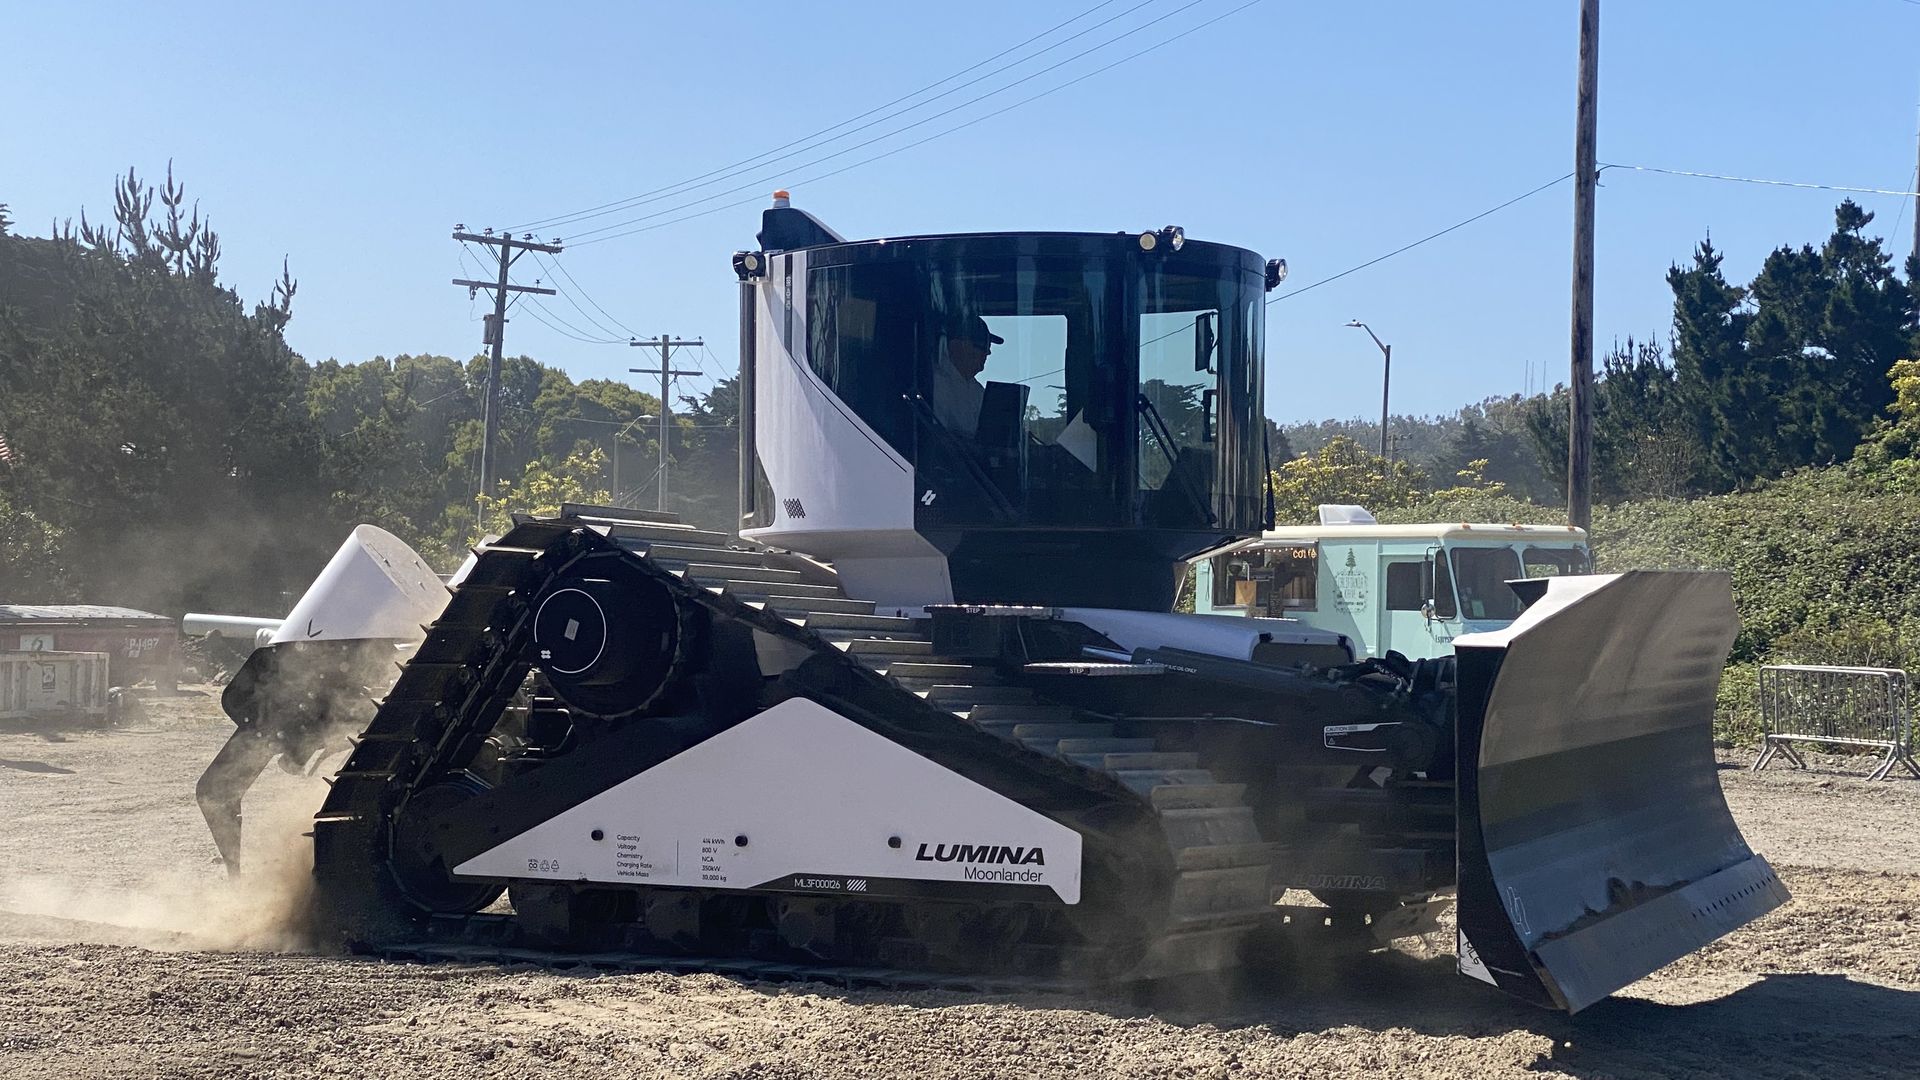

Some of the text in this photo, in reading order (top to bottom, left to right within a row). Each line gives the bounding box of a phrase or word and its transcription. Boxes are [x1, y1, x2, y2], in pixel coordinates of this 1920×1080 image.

[616, 834, 640, 842] Capacity
[616, 843, 636, 851] Voltage
[616, 852, 643, 860] Chemistry
[915, 843, 1045, 865] LUMINA
[616, 862, 640, 870] Charging
[964, 866, 1043, 882] Moonlander
[794, 878, 841, 890] ML3F000126
